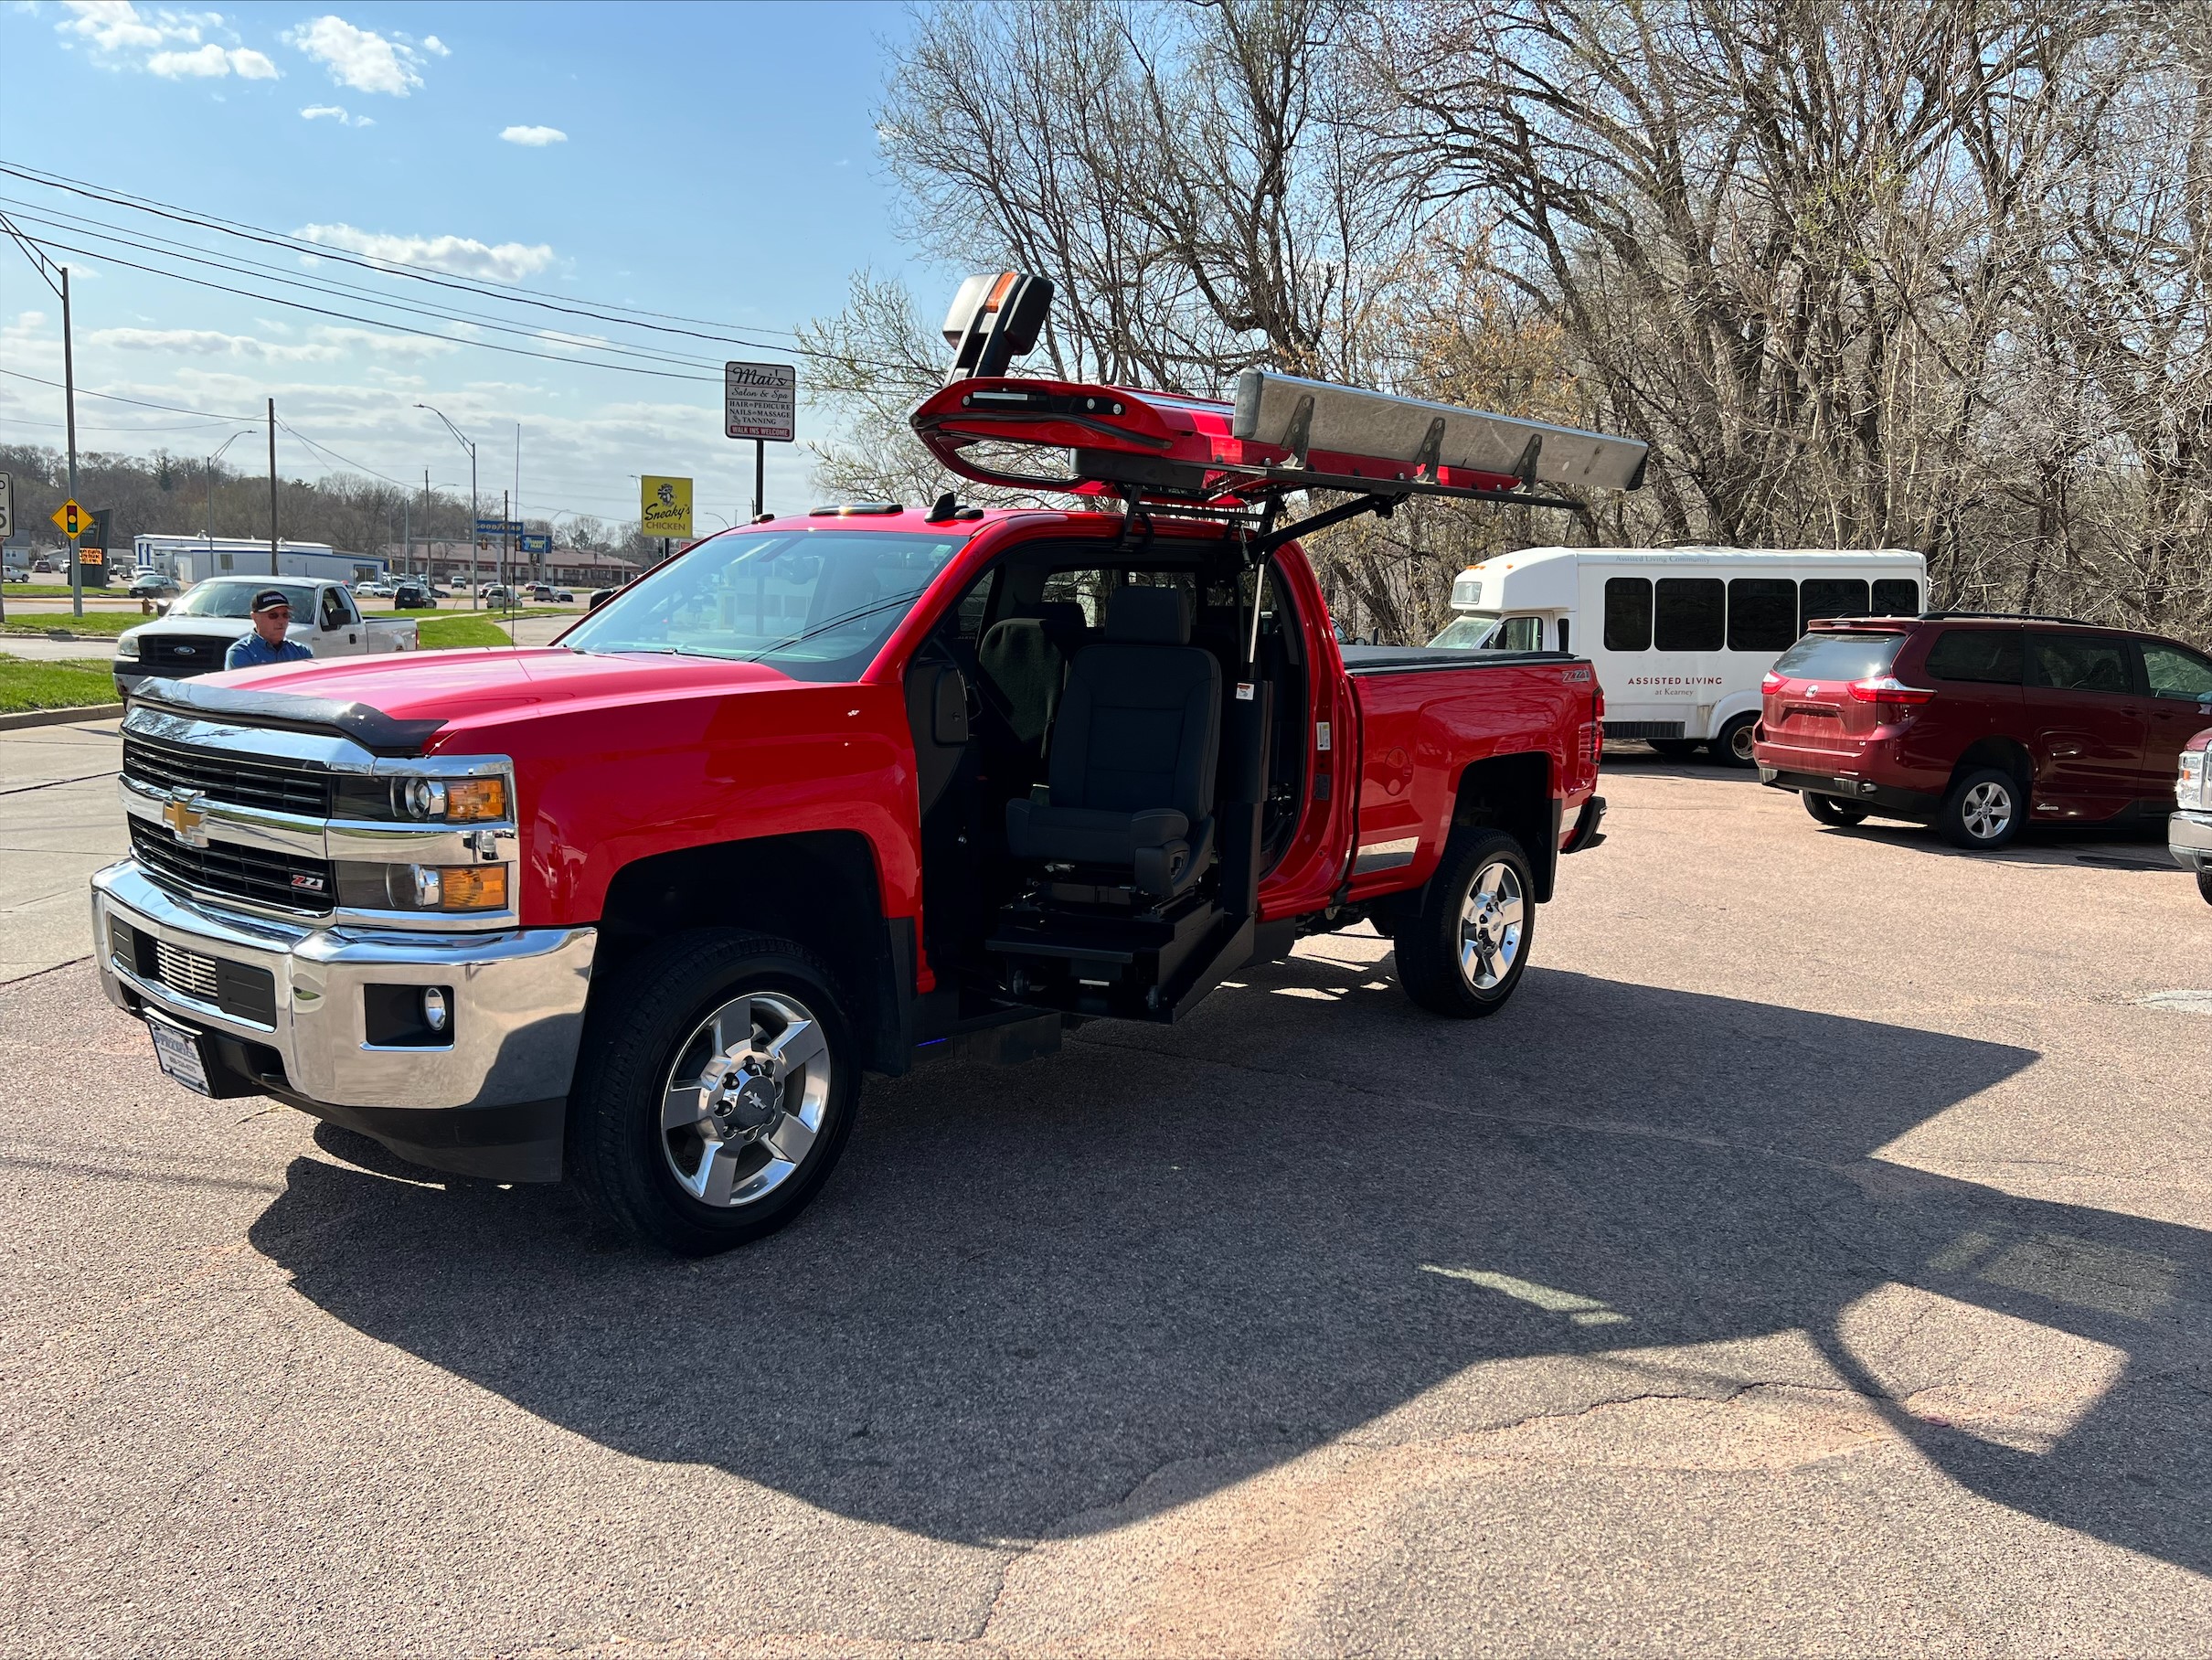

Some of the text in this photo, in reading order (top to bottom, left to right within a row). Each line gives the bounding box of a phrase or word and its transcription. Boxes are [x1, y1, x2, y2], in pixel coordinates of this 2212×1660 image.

[732, 367, 787, 386] Mai's
[731, 387, 789, 401] Salon & Spa
[754, 402, 791, 410] PEDICURE
[757, 410, 791, 419] MASSAGE
[742, 416, 776, 425] TANNING
[731, 426, 788, 437] WALK INS WELCOME
[644, 503, 691, 521] Sneaky's
[645, 521, 686, 531] CHICKEN
[1645, 555, 1667, 564] Living
[1669, 555, 1711, 564] Community
[1664, 688, 1694, 697] Kearney
[291, 874, 324, 890] Z71
